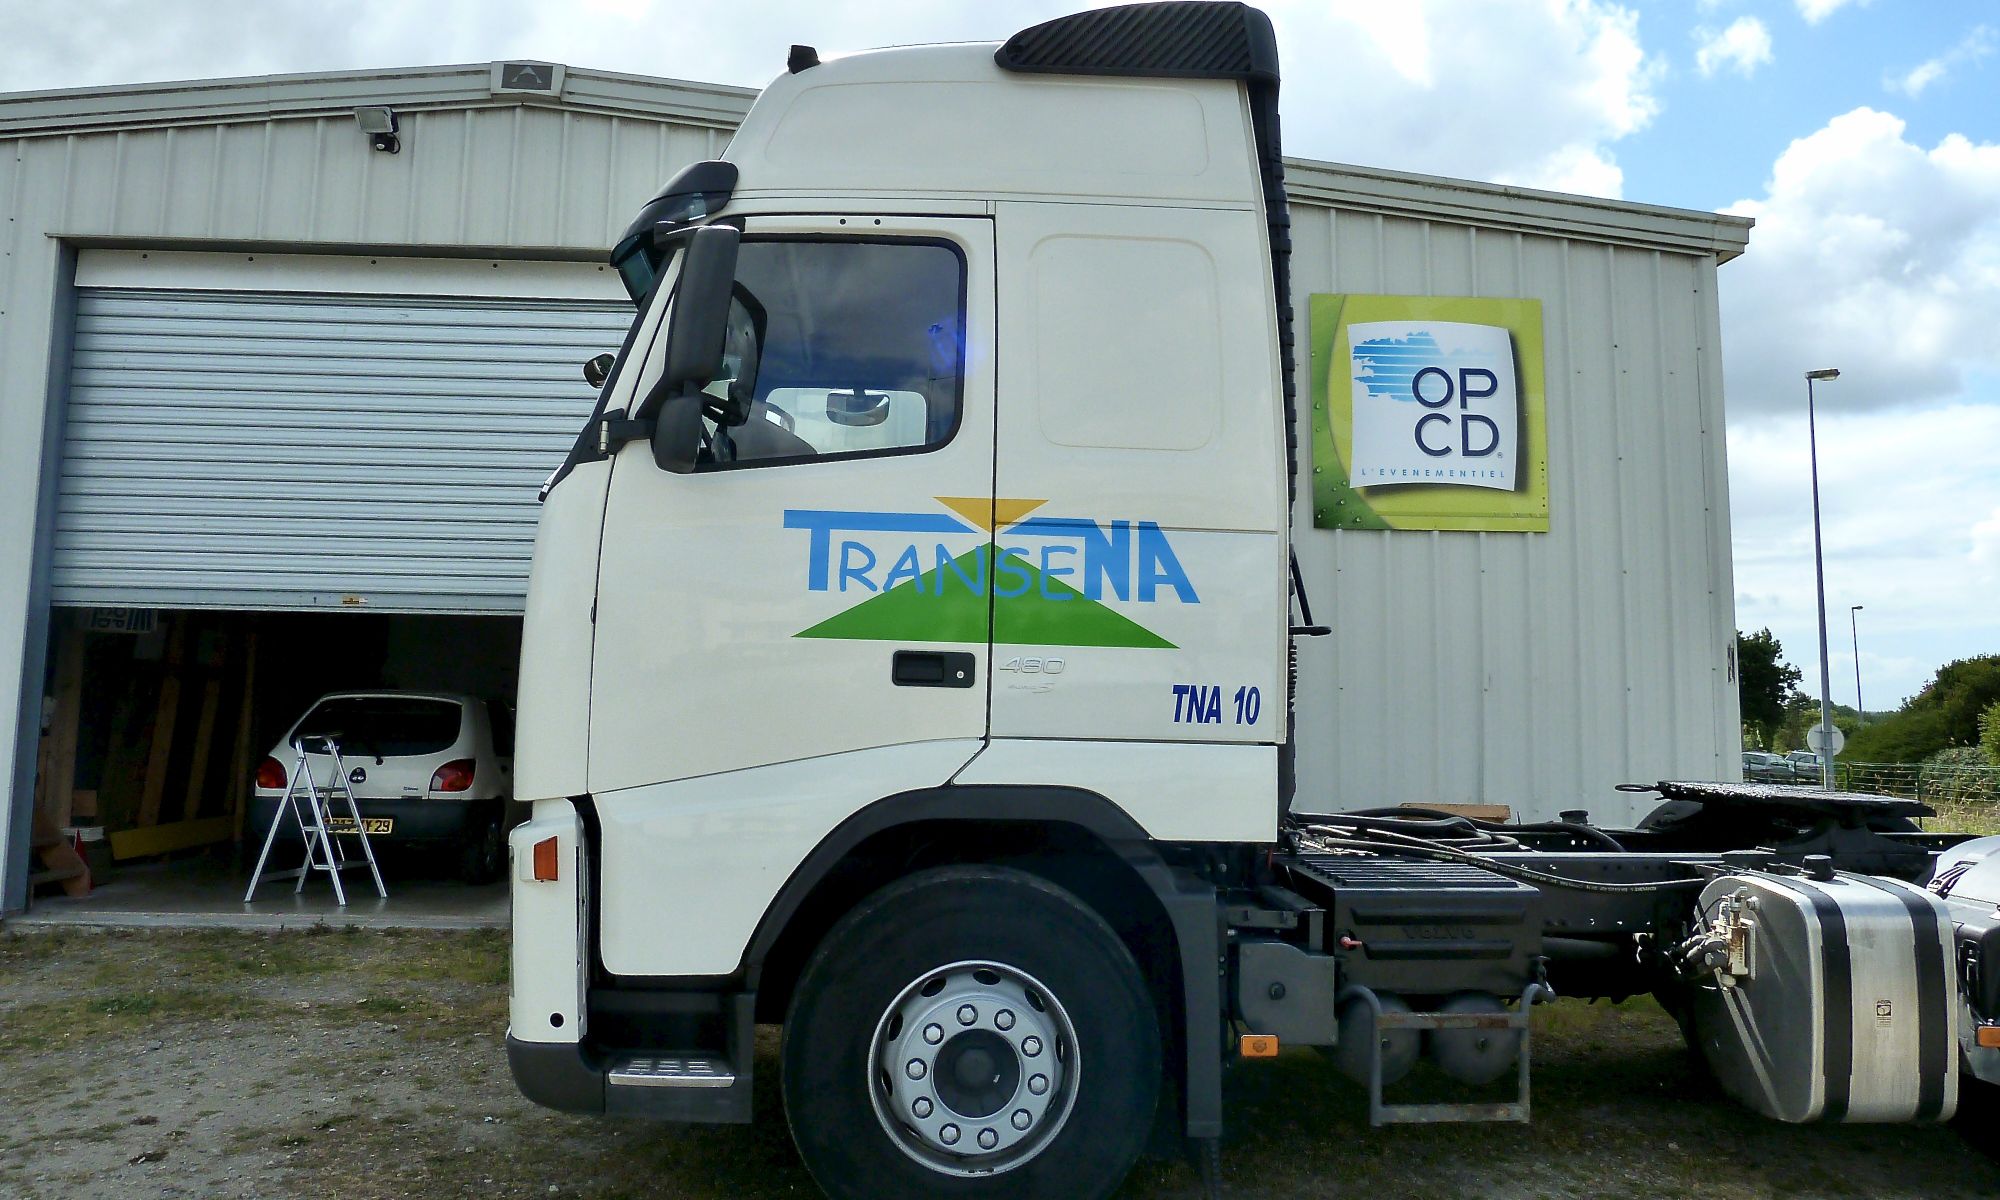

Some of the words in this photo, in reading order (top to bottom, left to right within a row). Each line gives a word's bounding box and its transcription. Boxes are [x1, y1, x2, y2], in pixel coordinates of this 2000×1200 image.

[1412, 367, 1498, 409] OP
[1414, 413, 1499, 456] CD
[1361, 468, 1504, 478] L'EVENEMENTIEL
[784, 510, 1200, 603] TRANSENA
[1000, 656, 1065, 674] 480
[1173, 685, 1221, 723] TNA
[1234, 686, 1260, 725] 10
[374, 820, 390, 832] 29
